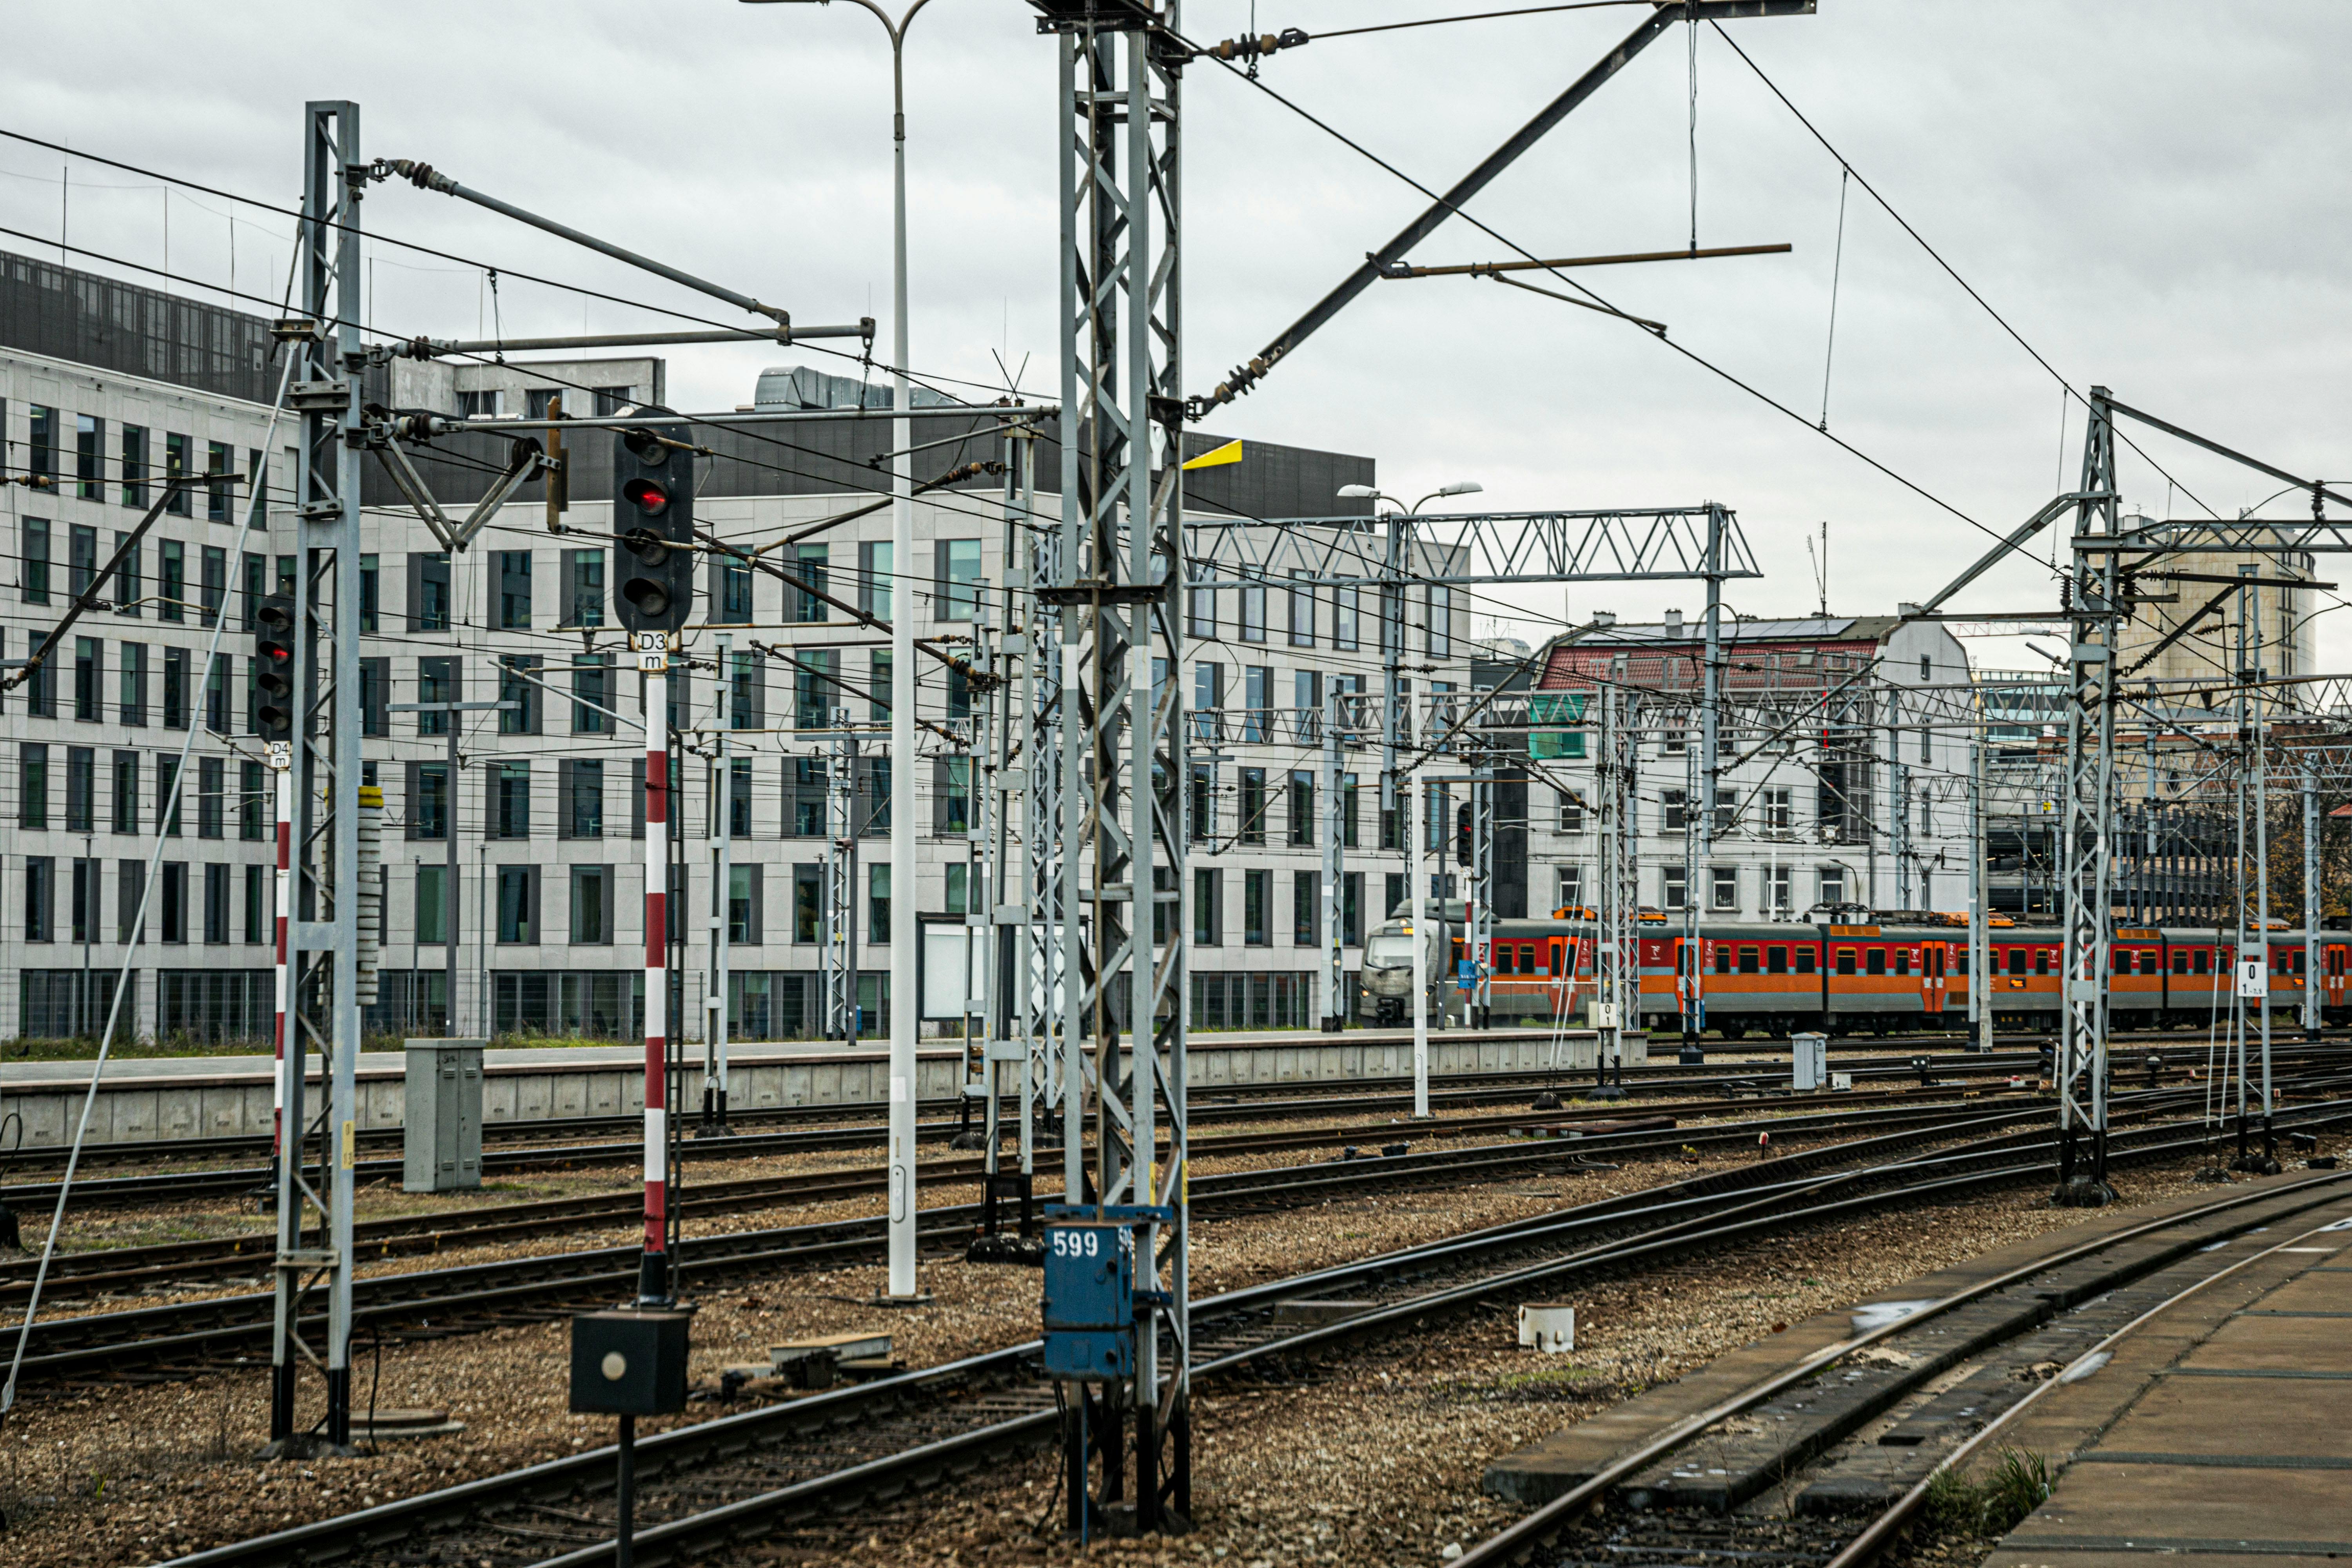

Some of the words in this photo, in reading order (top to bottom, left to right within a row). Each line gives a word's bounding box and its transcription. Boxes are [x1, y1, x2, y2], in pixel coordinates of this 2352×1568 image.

[642, 634, 665, 650] D3
[646, 656, 660, 668] m
[273, 743, 288, 754] D4
[276, 758, 285, 766] m
[2249, 965, 2255, 979] 0
[2243, 983, 2247, 994] 1
[1605, 1005, 1610, 1014] 0
[1607, 1016, 1609, 1025] 1
[1054, 1230, 1098, 1257] 599
